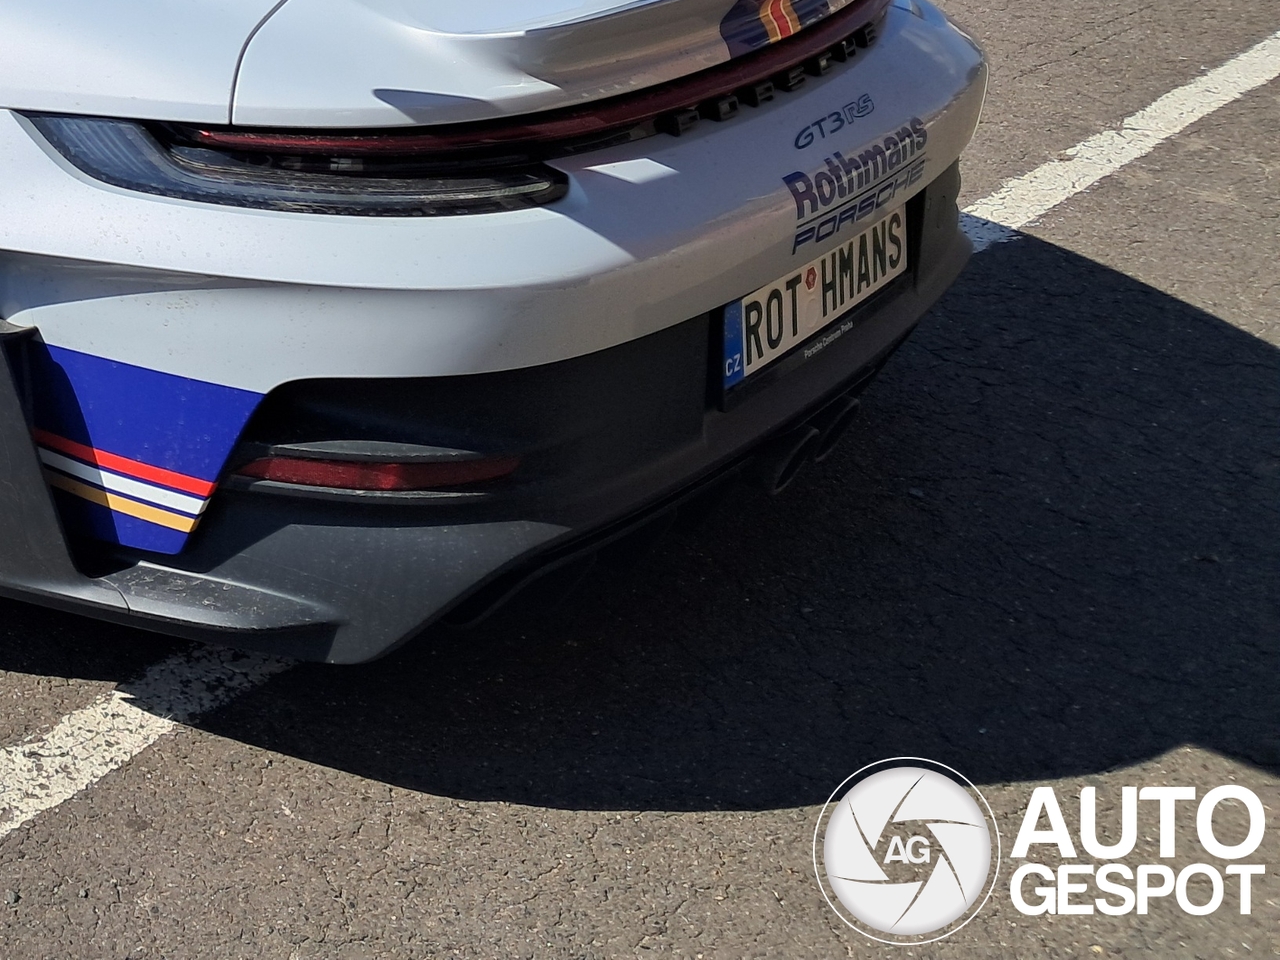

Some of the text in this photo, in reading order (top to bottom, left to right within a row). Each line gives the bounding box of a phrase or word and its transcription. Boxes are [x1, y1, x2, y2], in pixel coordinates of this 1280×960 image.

[782, 116, 928, 221] Rothmans
[791, 159, 926, 256] PORSCHE
[745, 212, 903, 367] ROT HMANS
[724, 353, 742, 377] CZ
[804, 341, 824, 360] Porsche
